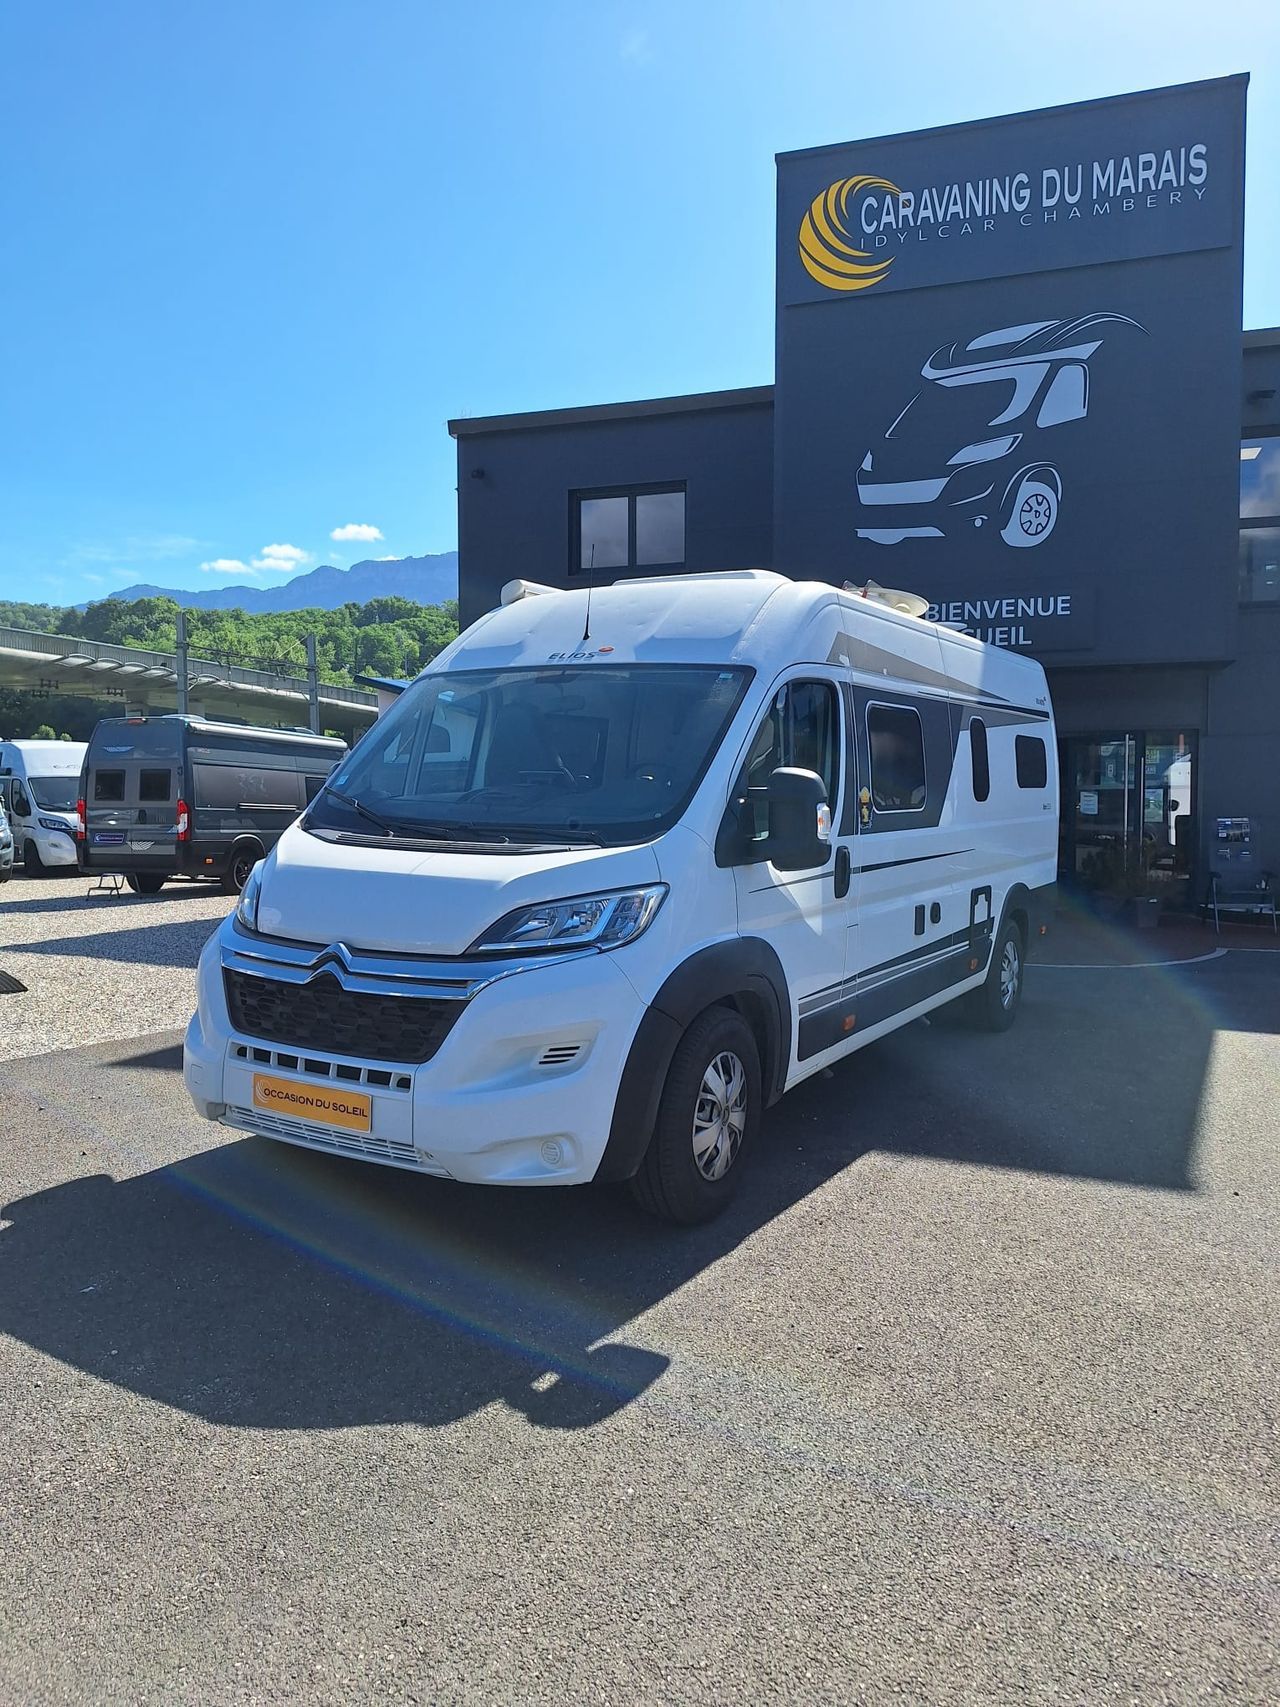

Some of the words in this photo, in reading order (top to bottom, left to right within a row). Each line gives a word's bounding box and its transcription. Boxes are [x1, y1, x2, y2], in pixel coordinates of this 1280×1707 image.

[861, 172, 1031, 234] CARAVANING
[1042, 164, 1082, 208] DU
[1092, 143, 1208, 200] MARAIS
[860, 219, 995, 249] IDYLCAR
[1020, 187, 1207, 226] CHAMBERY
[924, 595, 1071, 622] BIENVENUE
[548, 651, 596, 660] ELIOS
[263, 1087, 314, 1107] OCCASION
[315, 1098, 331, 1110] DU
[332, 1102, 368, 1118] SOLEIL
